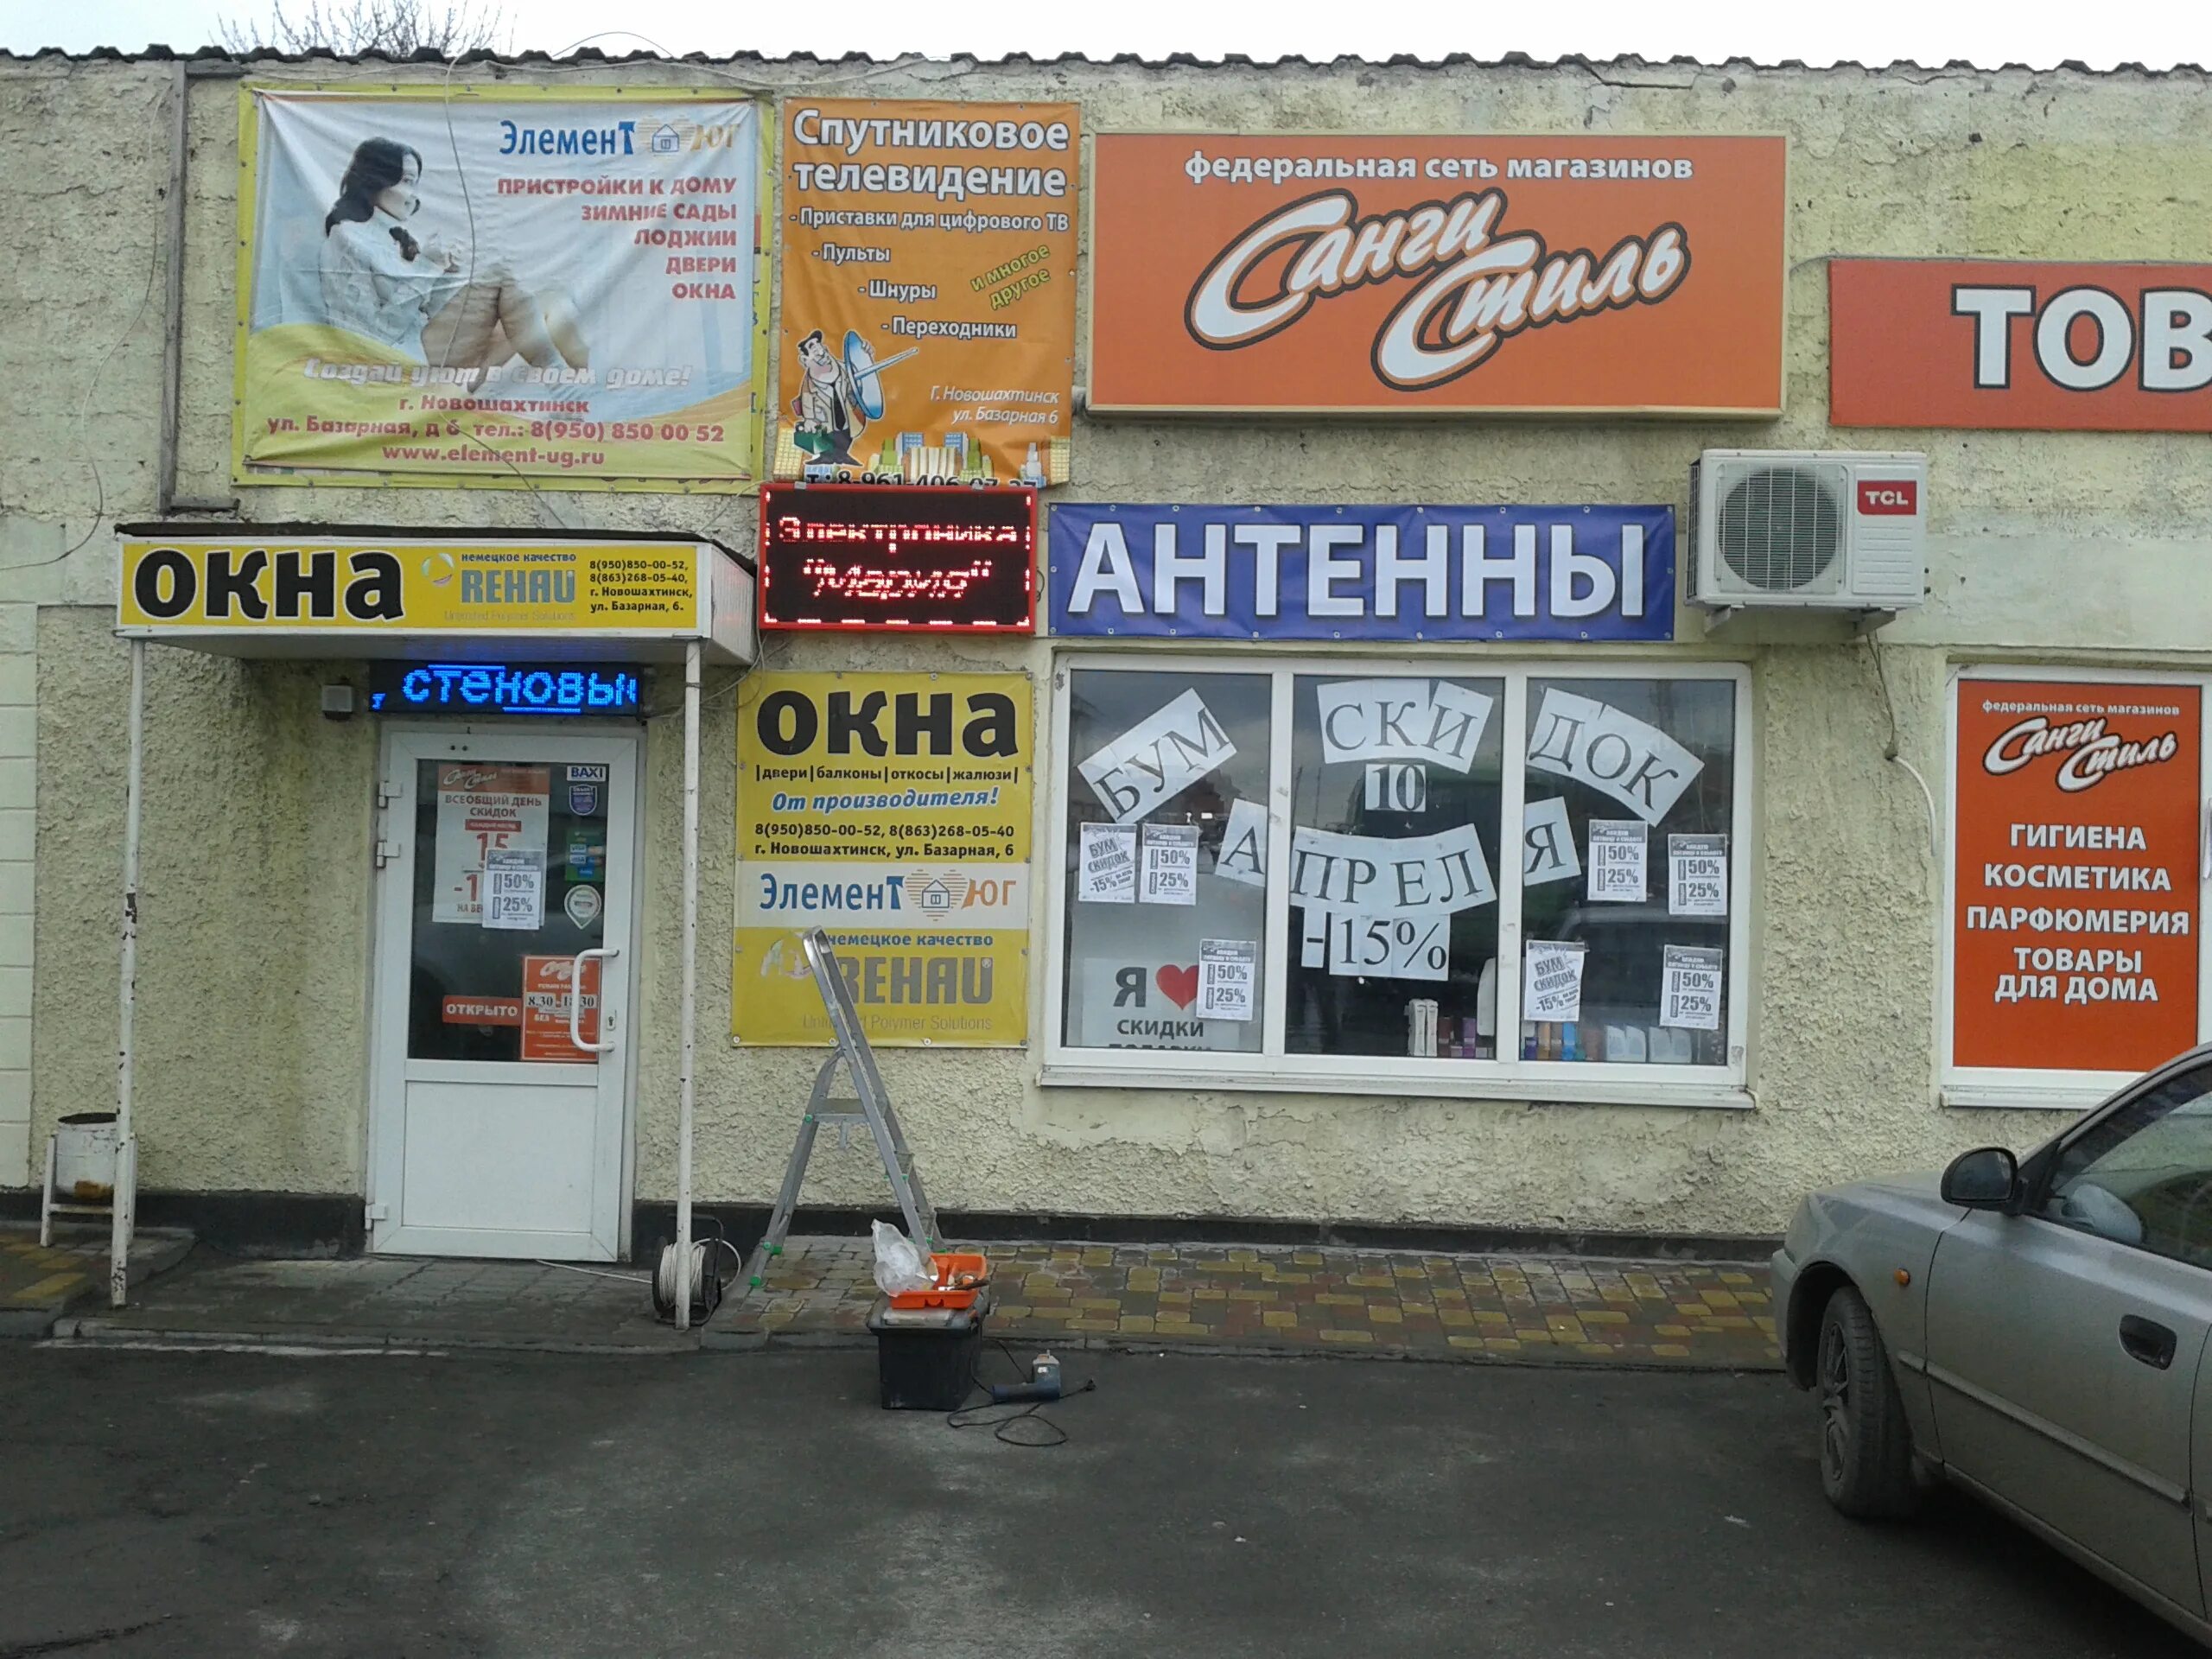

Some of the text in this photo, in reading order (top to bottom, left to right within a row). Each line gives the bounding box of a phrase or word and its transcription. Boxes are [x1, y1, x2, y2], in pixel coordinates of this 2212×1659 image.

[792, 109, 1070, 155] Спутниковое
[1185, 151, 1694, 184] федеральная сеть магазинов
[498, 175, 737, 194] ПРИСТРОЙКИ К ДОМУ
[792, 162, 1067, 201] телевидение
[582, 204, 736, 222] ЗИМНИЕ САДЫ
[800, 207, 898, 229] Приставки
[902, 213, 935, 231] для
[939, 210, 1042, 233] цифрового
[1046, 213, 1069, 232] ТВ
[634, 229, 736, 249] ЛОДЖИИ
[823, 243, 891, 266] Пульты
[985, 244, 1052, 283] многое
[665, 257, 736, 274] ДВЕРИ
[1187, 188, 1507, 346] Санги
[672, 283, 736, 300] ОКНА
[868, 280, 937, 302] Шнуры
[988, 269, 1052, 310] другое
[1374, 224, 1689, 390] Стиль
[893, 316, 1017, 339] Переходники
[607, 365, 693, 389] доме!
[399, 395, 589, 413] г. Новошахтинск
[943, 387, 1059, 404] Новошахтинск
[952, 407, 1058, 426] ул. Базарная 6
[268, 416, 299, 435] ул.
[306, 416, 418, 438] Базарная,
[474, 423, 524, 437] тел.:
[531, 421, 604, 442] 8(950)
[612, 423, 653, 440] 850
[661, 423, 689, 441] 00
[696, 425, 724, 442] 52
[382, 444, 604, 467] www.element-ug.ru
[1866, 490, 1908, 505] TCL
[461, 554, 519, 563] немецкое
[1067, 523, 1643, 616] АНТЕННЫ
[461, 569, 575, 603] REHAU
[590, 603, 607, 613] ул.
[1982, 700, 2180, 715] федеральная сеть магазинов
[1984, 716, 2107, 774] Санги
[1093, 707, 1230, 820] БУМ
[1372, 765, 1425, 810] 10
[2056, 731, 2177, 791] Стиль
[571, 766, 603, 778] BAXI
[445, 795, 543, 808] ВСЕОБЩИЙ ДЕНЬ
[772, 786, 1000, 814] От производителя!
[469, 807, 517, 818] СКИДОК
[755, 823, 1014, 840] 8(950)850-00-52, 8(863)268-05-40
[2011, 823, 2146, 850] ГИГИЕНА
[770, 842, 891, 857] Новошахтинск,
[895, 846, 919, 859] ул.
[1005, 845, 1014, 856] 6
[1160, 849, 1191, 865] 50%
[1608, 845, 1639, 861] 50%
[1607, 868, 1639, 884] 25%
[1688, 860, 1719, 874] 50%
[504, 874, 534, 889] 50%
[1159, 872, 1190, 887] 25%
[1985, 863, 2171, 891] КОСМЕТИКА
[1688, 882, 1719, 898] 25%
[503, 897, 532, 912] 25%
[1967, 906, 2189, 935] ПАРФЮМЕРИЯ
[917, 935, 993, 946] качество
[1306, 918, 1446, 969] -15%
[2013, 947, 2142, 973] ТОВАРЫ
[1217, 964, 1248, 980] 50%
[1682, 972, 1714, 988] 50%
[1113, 967, 1147, 1007] Я
[1216, 988, 1246, 1003] 25%
[1995, 975, 2158, 1005] ДЛЯ ДОМА
[446, 1003, 518, 1017] ОТКРЫТО
[1681, 995, 1712, 1012] 25%
[931, 1015, 993, 1030] Solutions
[1117, 1020, 1204, 1039] СКИДКИ
